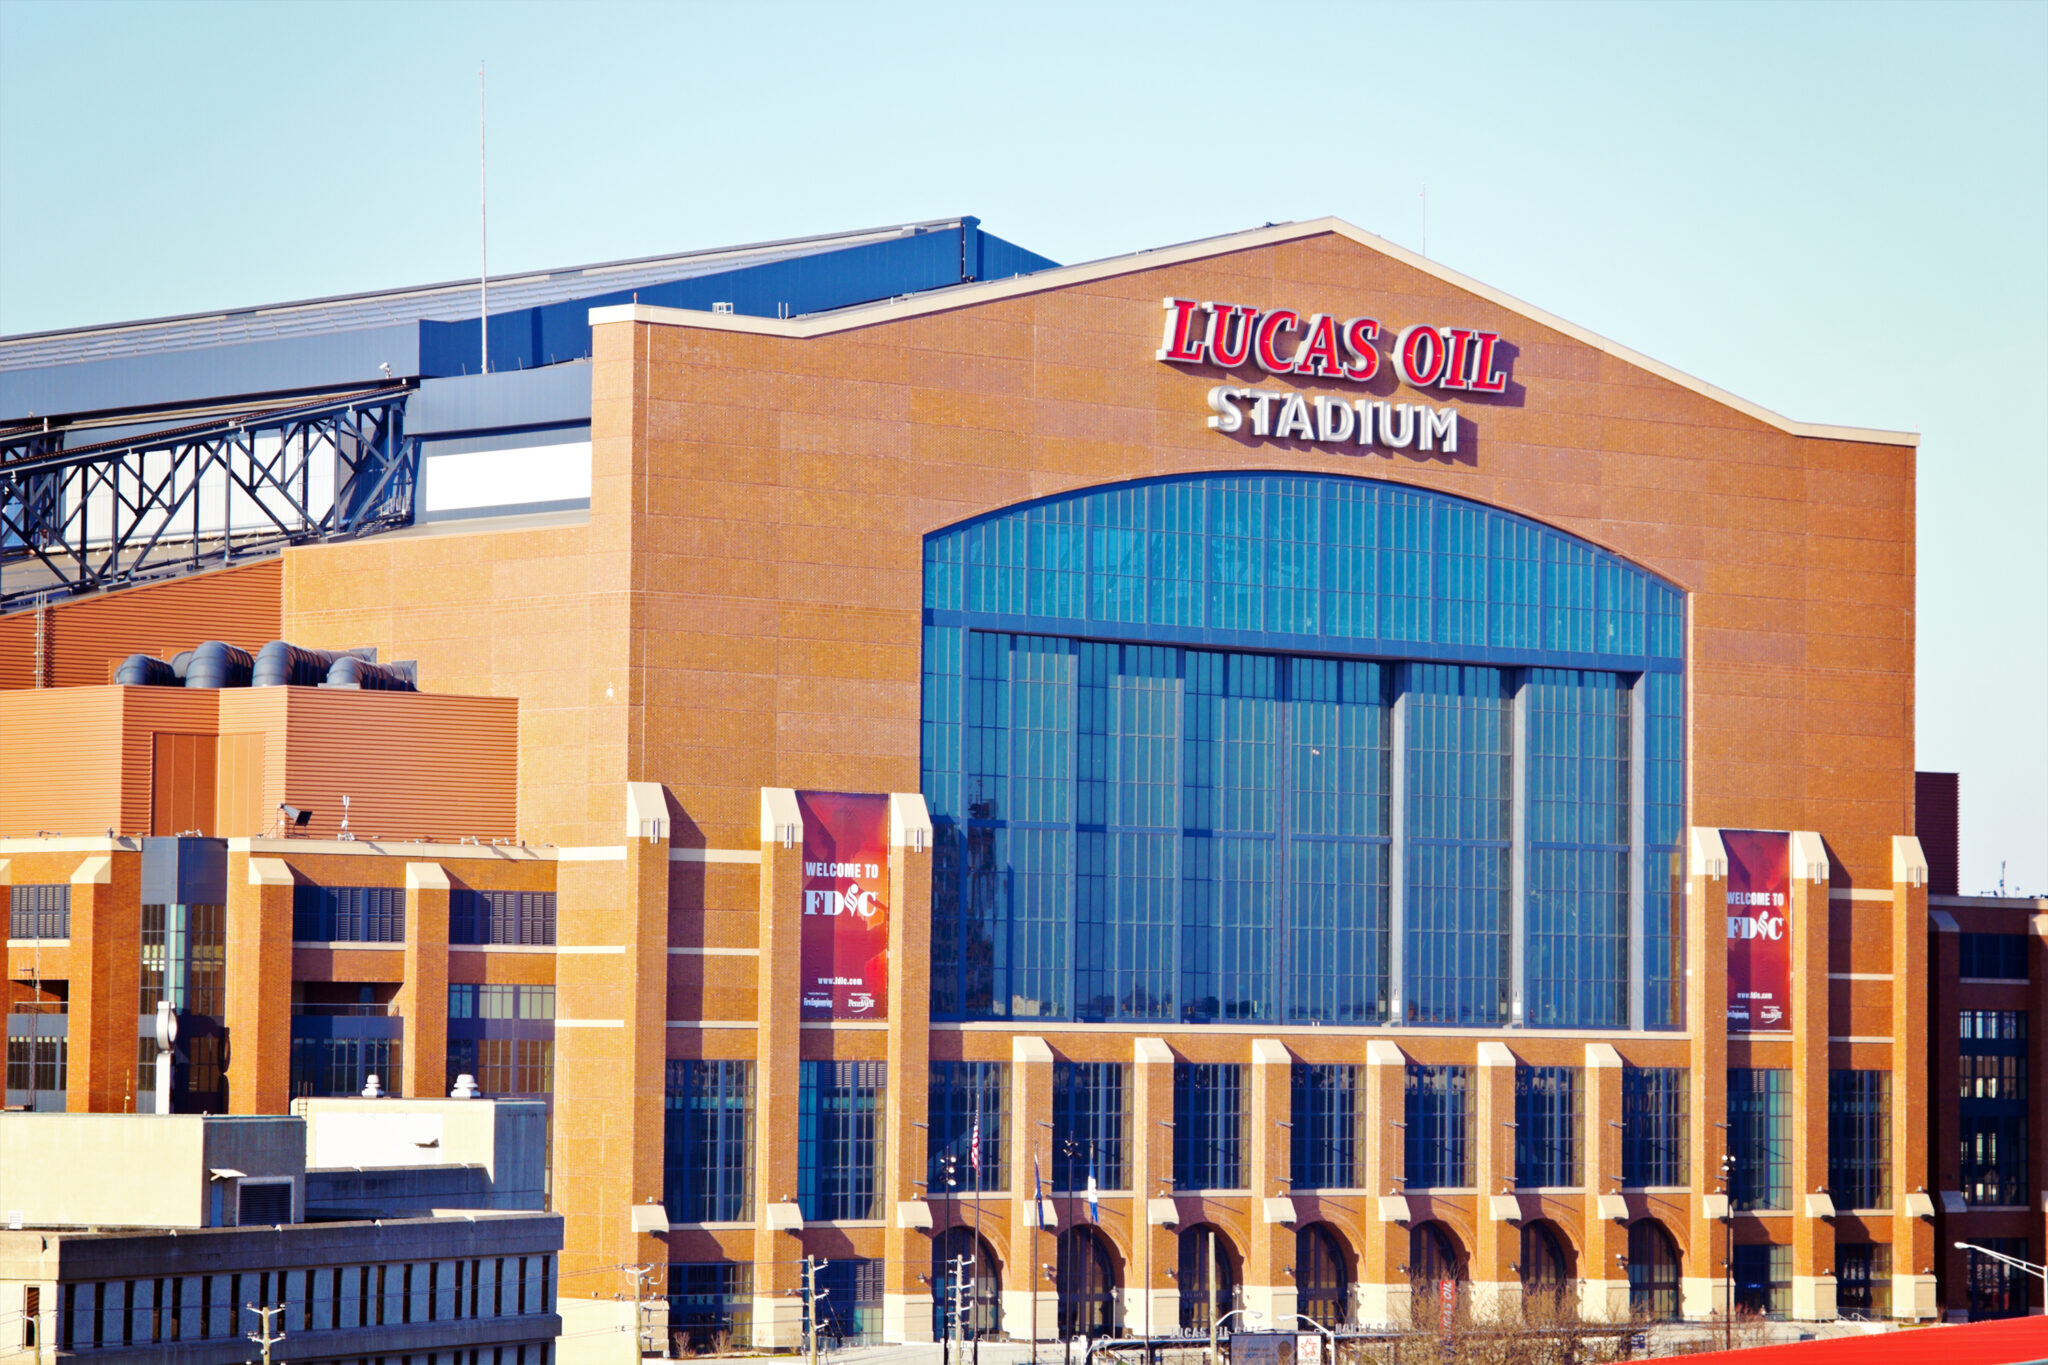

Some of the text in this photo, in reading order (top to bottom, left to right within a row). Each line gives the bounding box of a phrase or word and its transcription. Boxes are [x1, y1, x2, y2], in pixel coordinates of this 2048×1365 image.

[1156, 297, 1506, 393] LUCAS OIL
[1207, 386, 1458, 453] STADIUM
[805, 862, 879, 878] WELCOME TO
[1727, 892, 1785, 906] WELCOME TO
[1443, 1282, 1453, 1300] OIL
[1169, 1327, 1207, 1339] LUCAS
